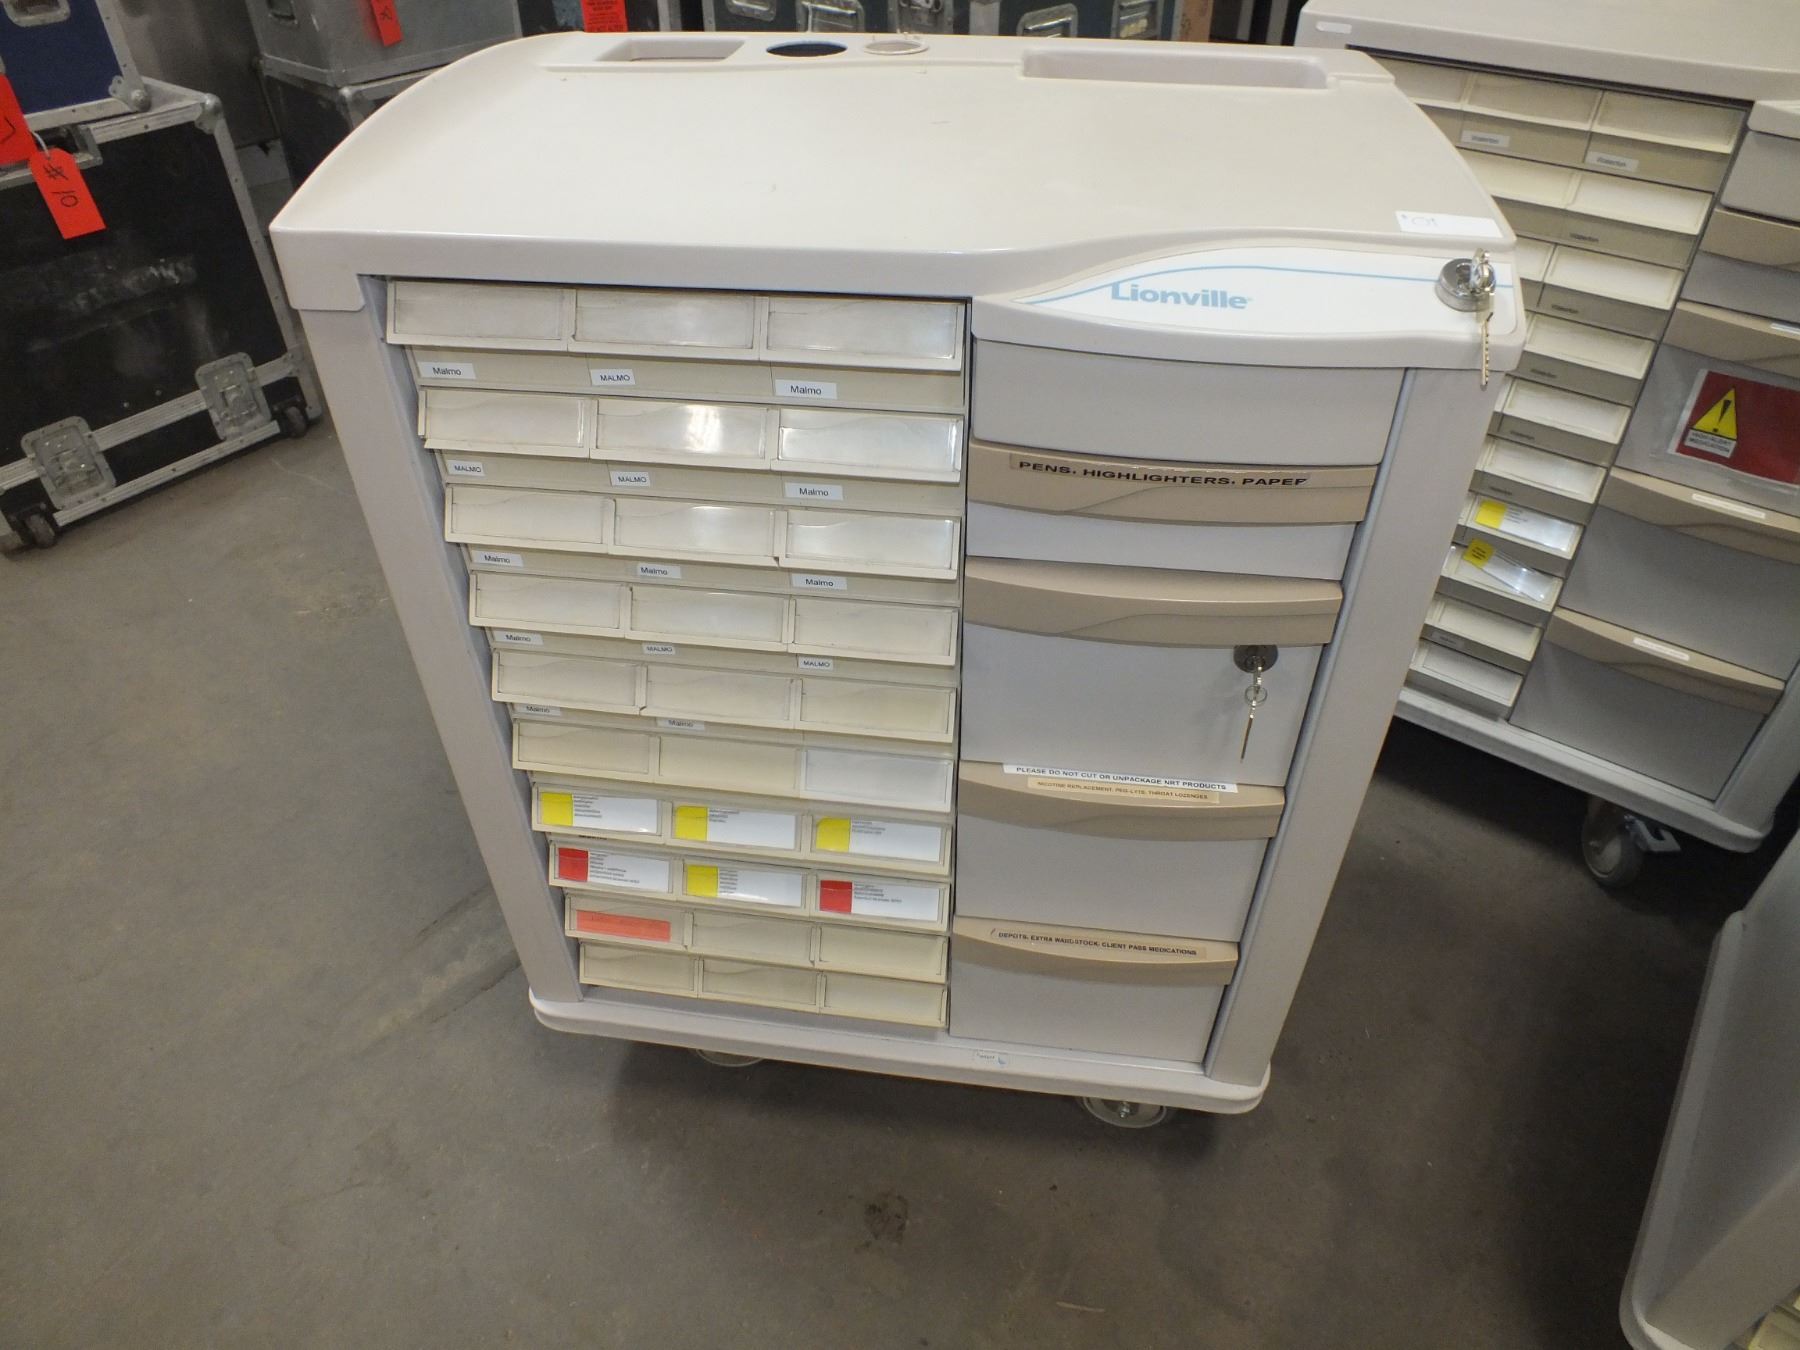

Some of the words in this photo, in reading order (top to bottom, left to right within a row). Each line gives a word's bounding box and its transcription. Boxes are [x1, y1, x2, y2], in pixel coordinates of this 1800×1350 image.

[1111, 281, 1248, 310] Lionville
[432, 366, 462, 376] Malmo
[600, 374, 631, 382] MALMO
[790, 385, 822, 396] Malmo
[454, 465, 482, 473] MALMO
[617, 475, 647, 483] MALMO
[799, 487, 829, 497] Malmo
[484, 554, 511, 564] Malmo
[640, 566, 668, 576] Malmo
[805, 578, 834, 587] Malmo
[505, 634, 531, 643] Malmo
[803, 660, 831, 668] MALMO
[526, 705, 550, 714] Malmo
[668, 719, 694, 728] Malmo
[1016, 767, 1046, 775] PLEASE
[1112, 775, 1162, 785] UNPACKAGE
[1182, 781, 1227, 790] PRODUCTS
[1175, 792, 1209, 800] LOZENGES
[1031, 934, 1053, 942] EXTRA
[1102, 942, 1127, 950] CLIENT
[1149, 946, 1197, 956] MEDICATIONS
